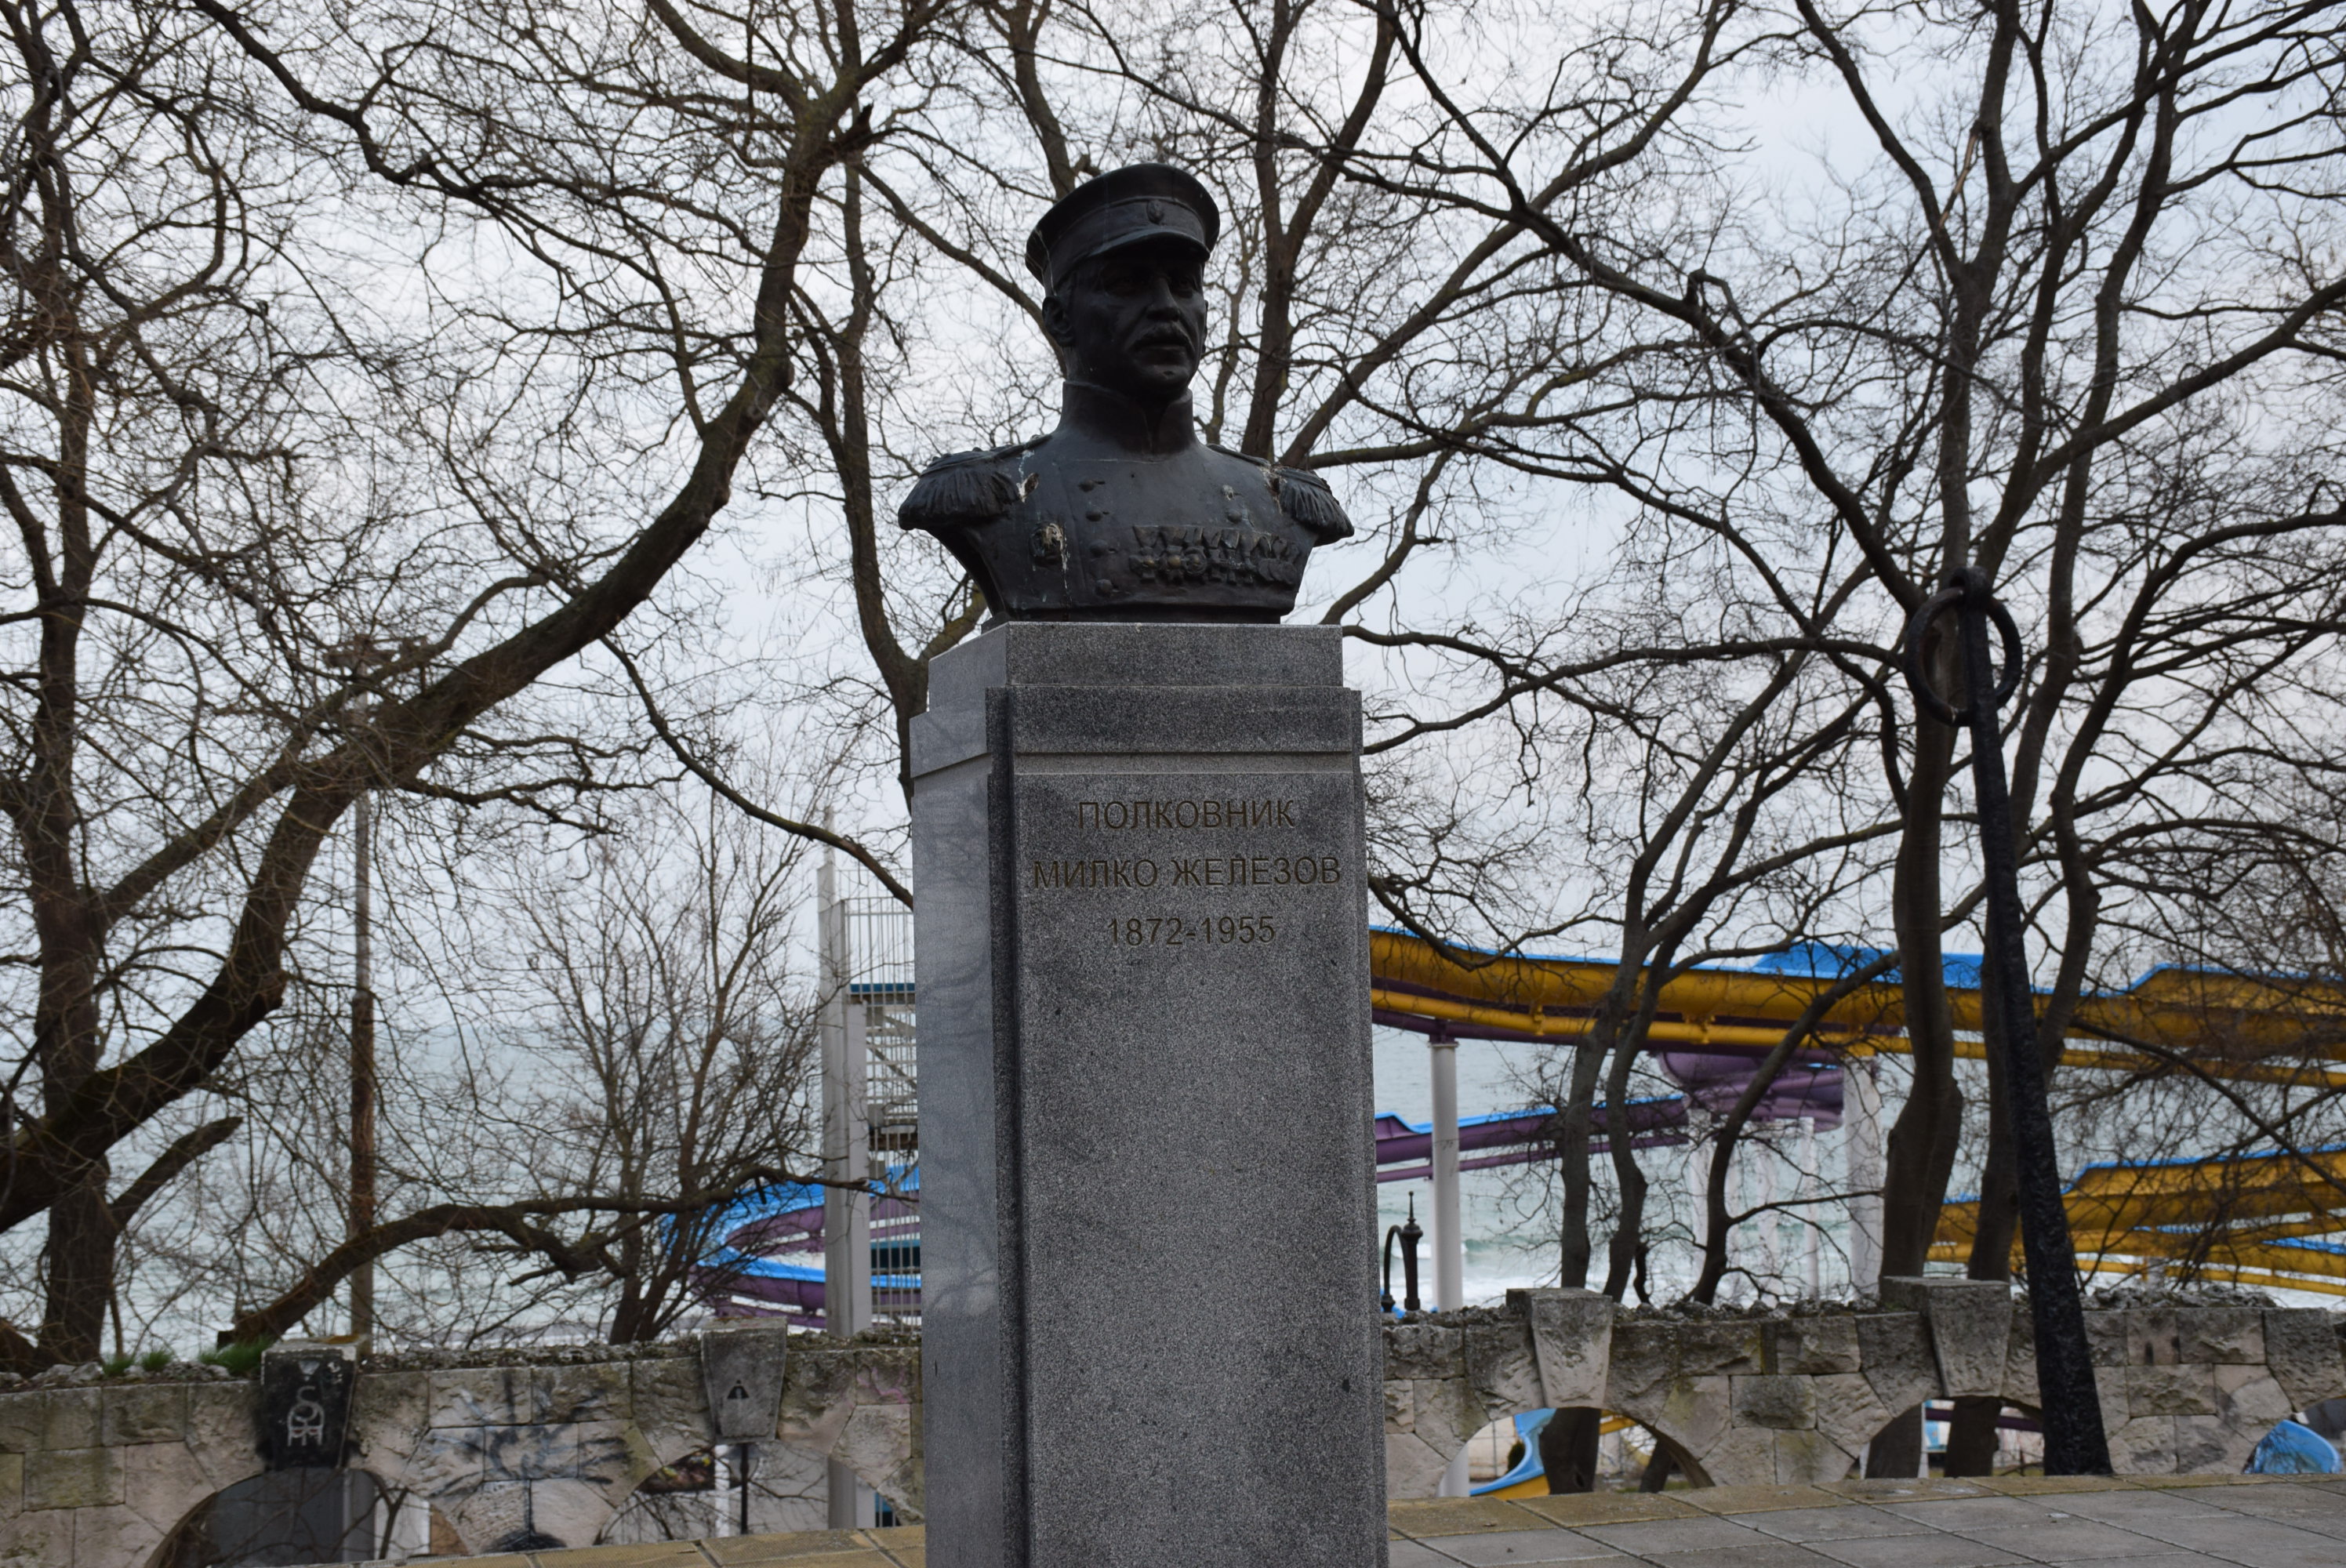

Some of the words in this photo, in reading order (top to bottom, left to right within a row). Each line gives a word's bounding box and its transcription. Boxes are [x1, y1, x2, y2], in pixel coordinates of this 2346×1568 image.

[1078, 800, 1295, 829] ПОЛКОВНИК
[1033, 859, 1158, 888] МИЛКО
[1171, 857, 1341, 887] ЖЕЛЕЗОВ
[1107, 916, 1276, 946] 1872-1955
